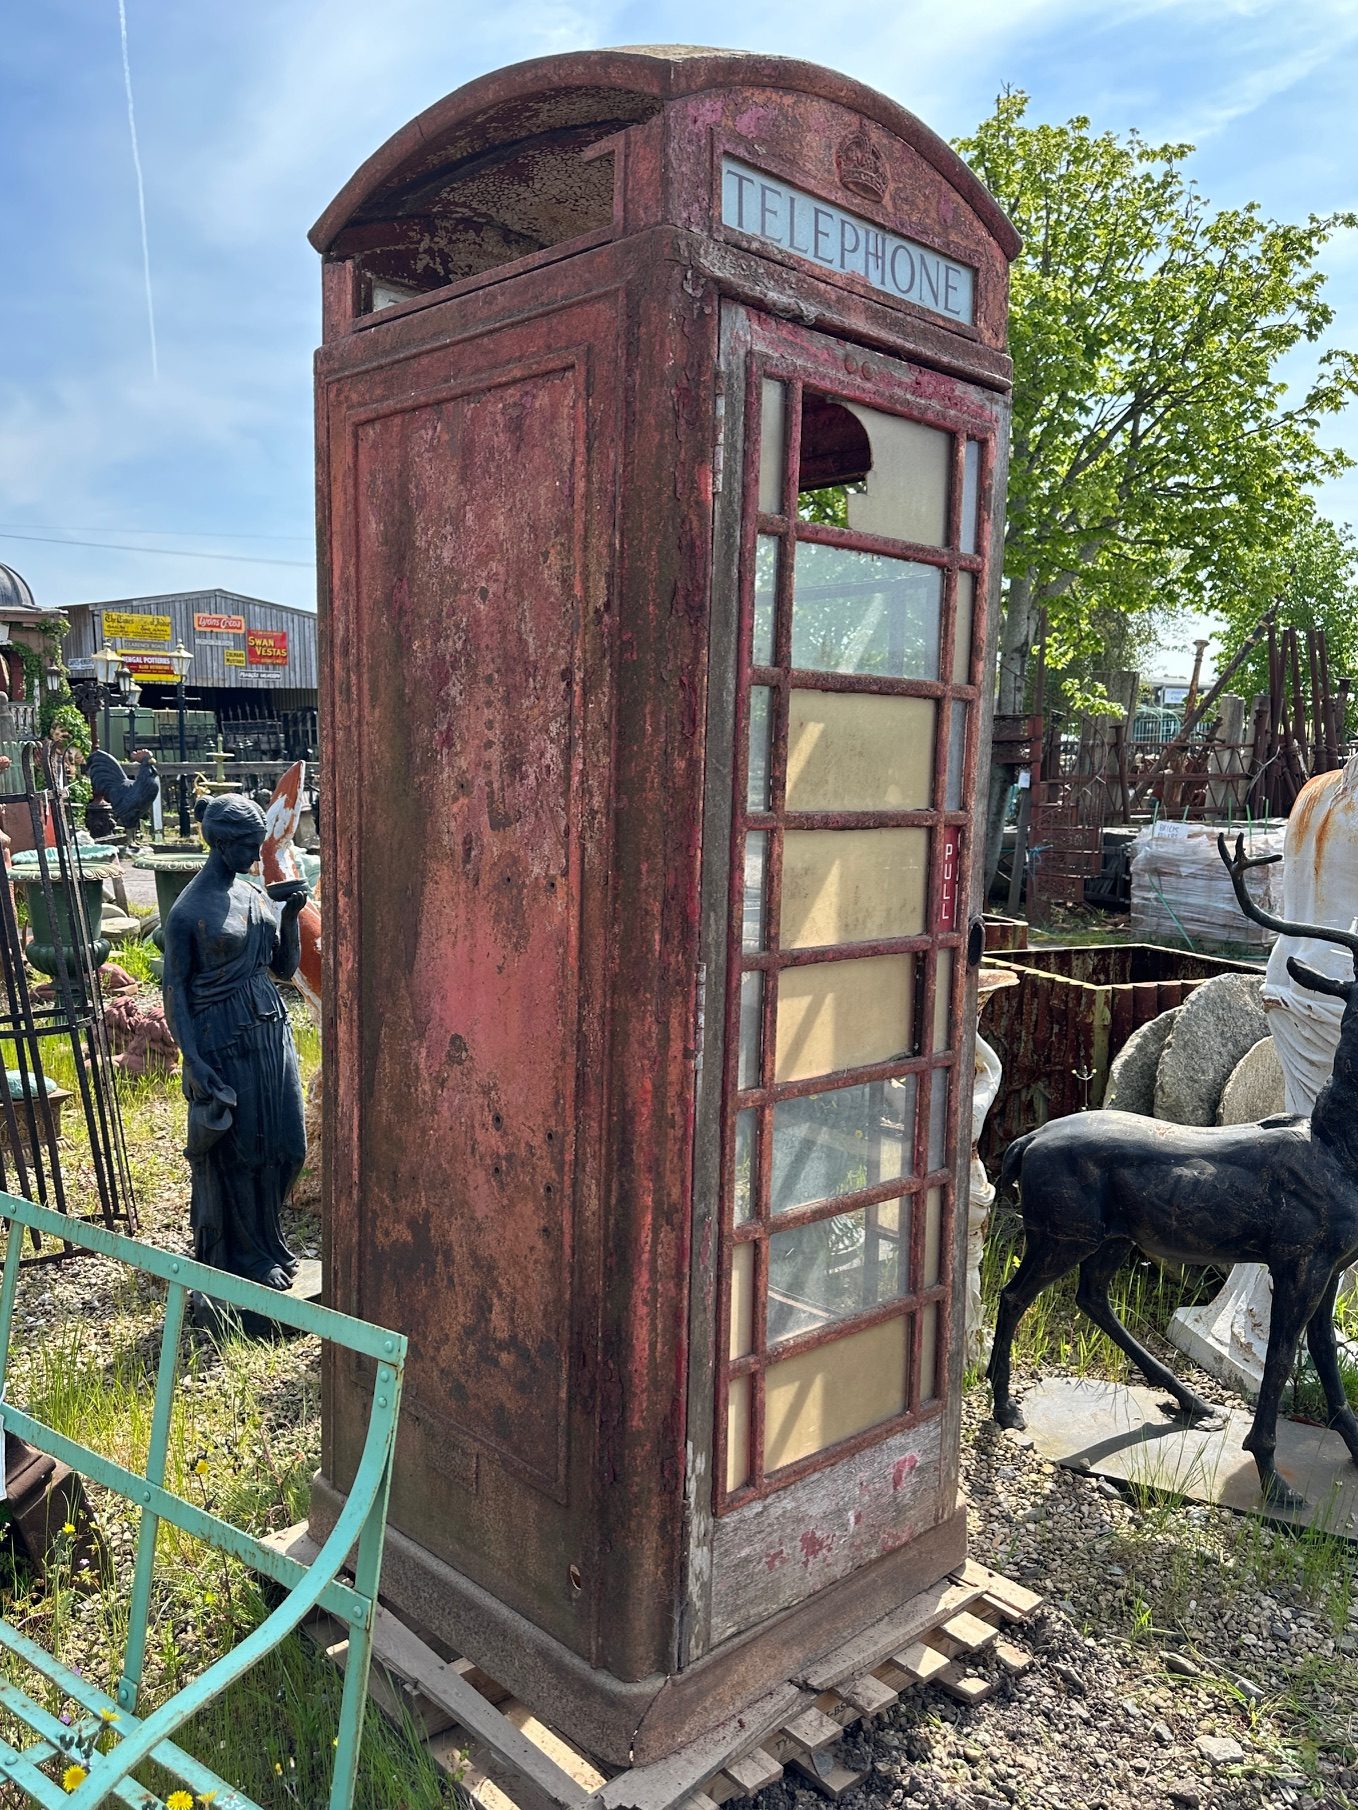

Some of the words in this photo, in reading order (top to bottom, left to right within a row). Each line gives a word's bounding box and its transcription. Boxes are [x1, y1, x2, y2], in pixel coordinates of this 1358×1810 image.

[726, 169, 962, 316] TELEPHONE
[199, 616, 220, 627] Lyons
[220, 618, 241, 629] Cocoa
[248, 636, 274, 647] SWAN
[256, 647, 287, 657] VESTAS
[942, 843, 953, 920] PULL
